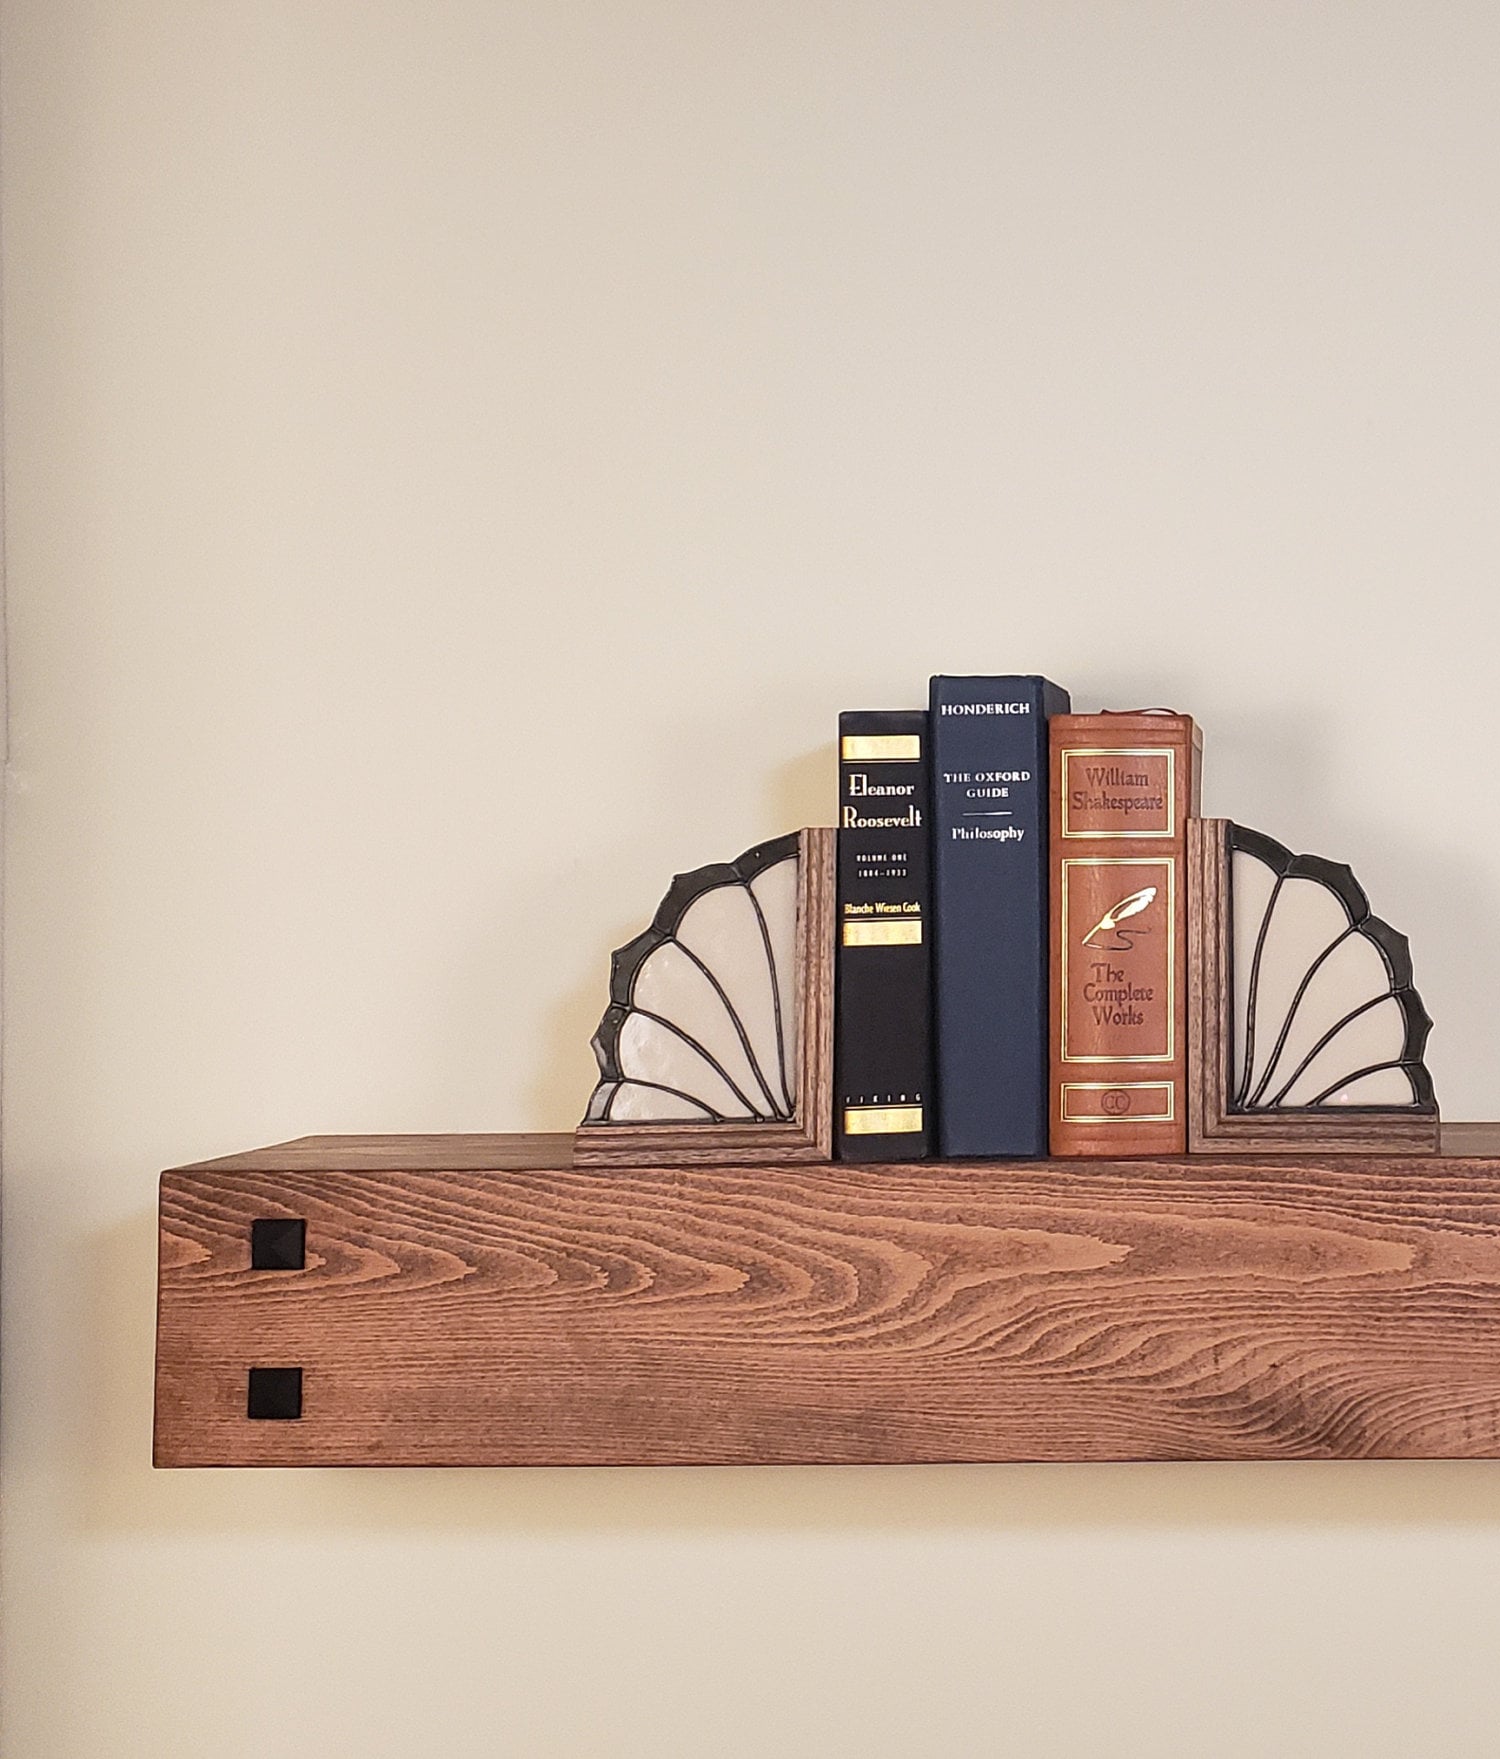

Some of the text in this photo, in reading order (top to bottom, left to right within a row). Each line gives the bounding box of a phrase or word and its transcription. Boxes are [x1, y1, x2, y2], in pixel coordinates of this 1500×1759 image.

[941, 703, 1031, 716] HONDERICH
[849, 774, 915, 796] Eleanor
[943, 771, 1031, 783] THE OXFORD
[1085, 767, 1149, 787] William
[966, 787, 1009, 798] GUIDE
[1072, 791, 1163, 815] Shakespeare
[843, 804, 922, 829] Roosevelt
[952, 825, 1025, 842] Philosophy
[844, 903, 874, 914] Blanche
[902, 901, 921, 912] Cook
[1090, 962, 1125, 983] The
[1083, 982, 1154, 1007] Complete
[1092, 1005, 1144, 1026] Works
